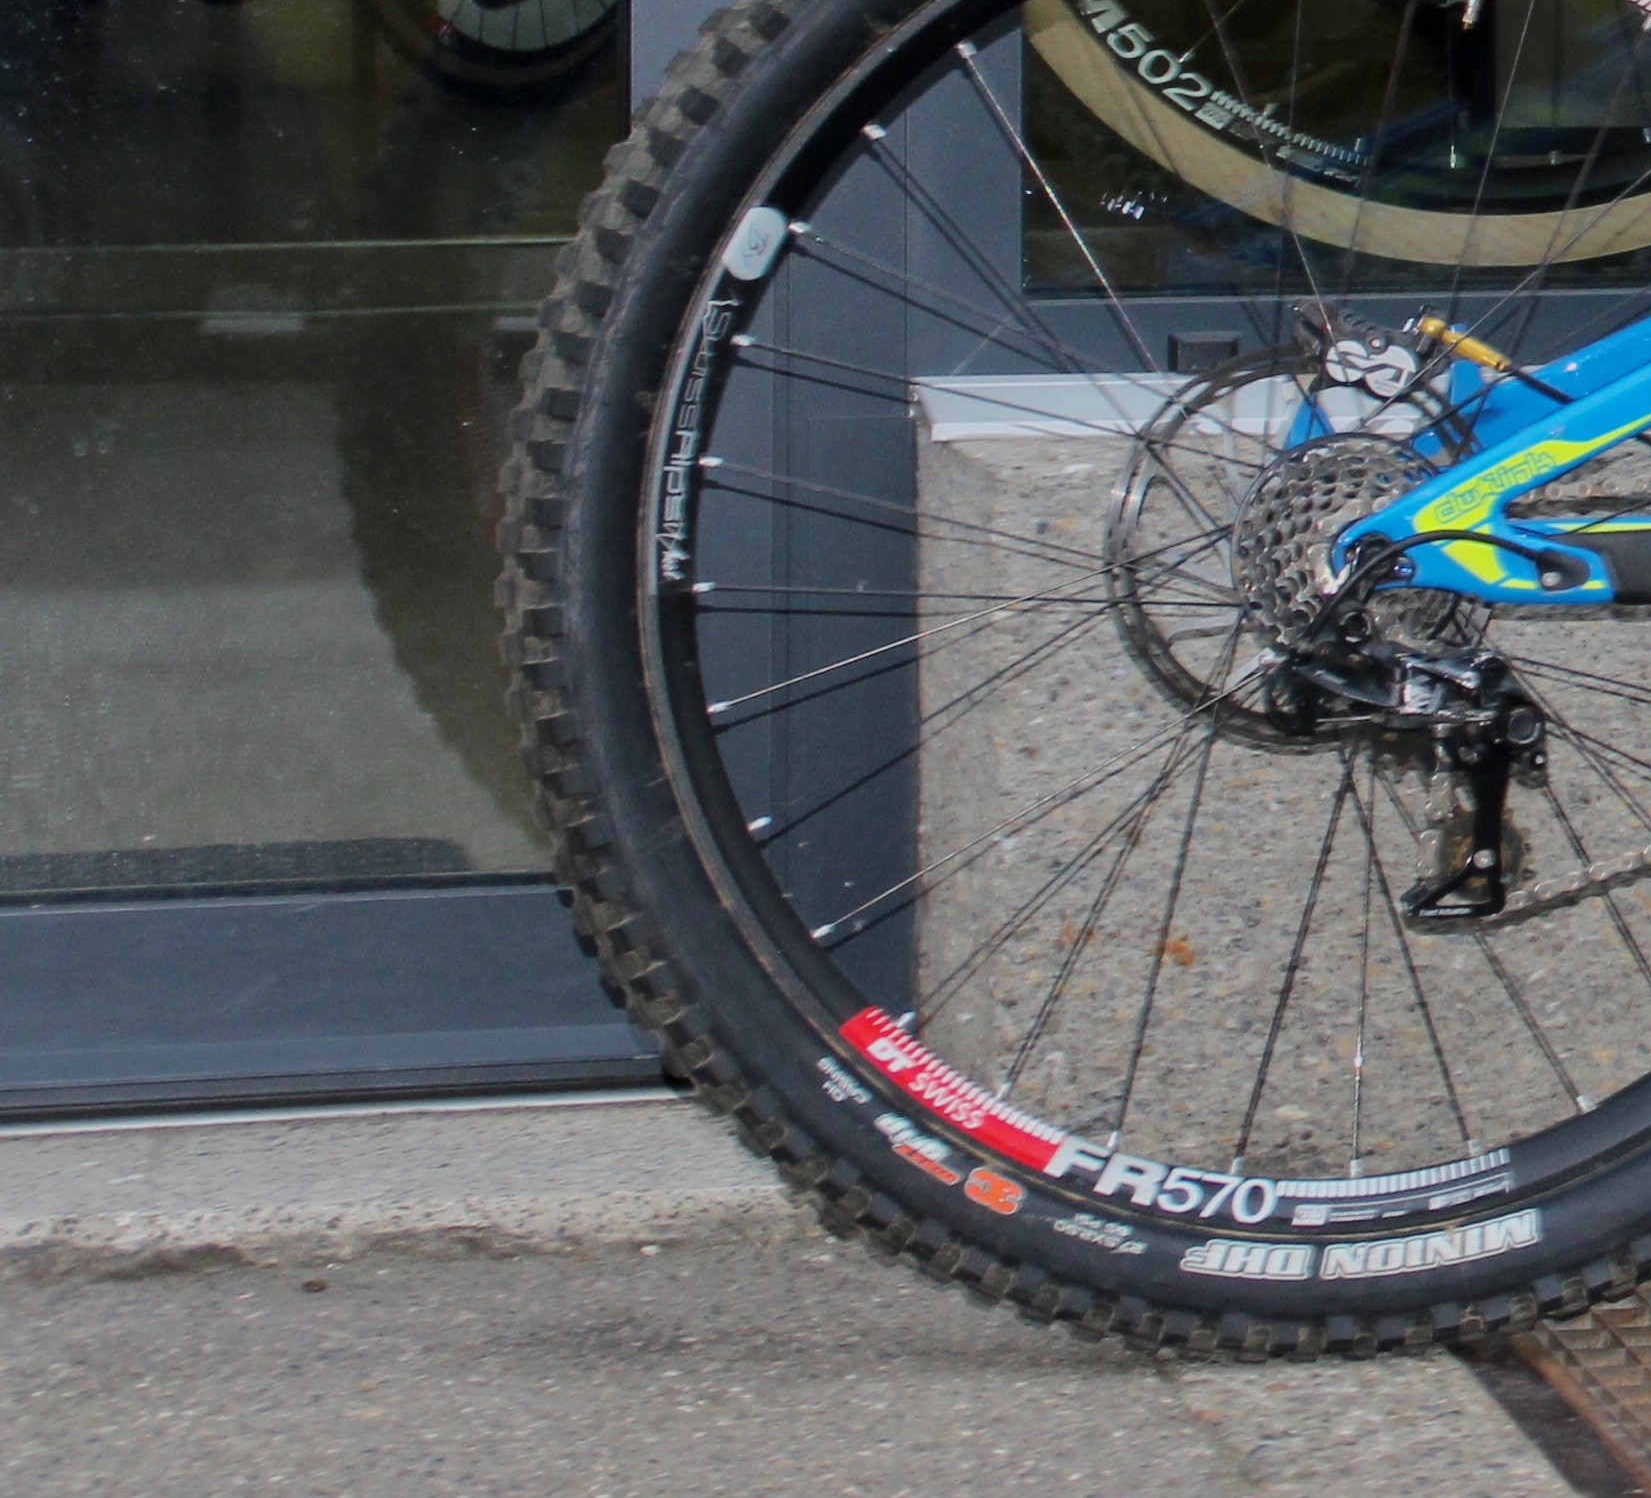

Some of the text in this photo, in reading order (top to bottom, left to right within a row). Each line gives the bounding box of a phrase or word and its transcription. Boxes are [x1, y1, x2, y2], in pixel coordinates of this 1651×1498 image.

[867, 1037, 989, 1130] DT SWISS
[1042, 1135, 1280, 1225] FR570
[1179, 1207, 1544, 1282] MINION DHF
